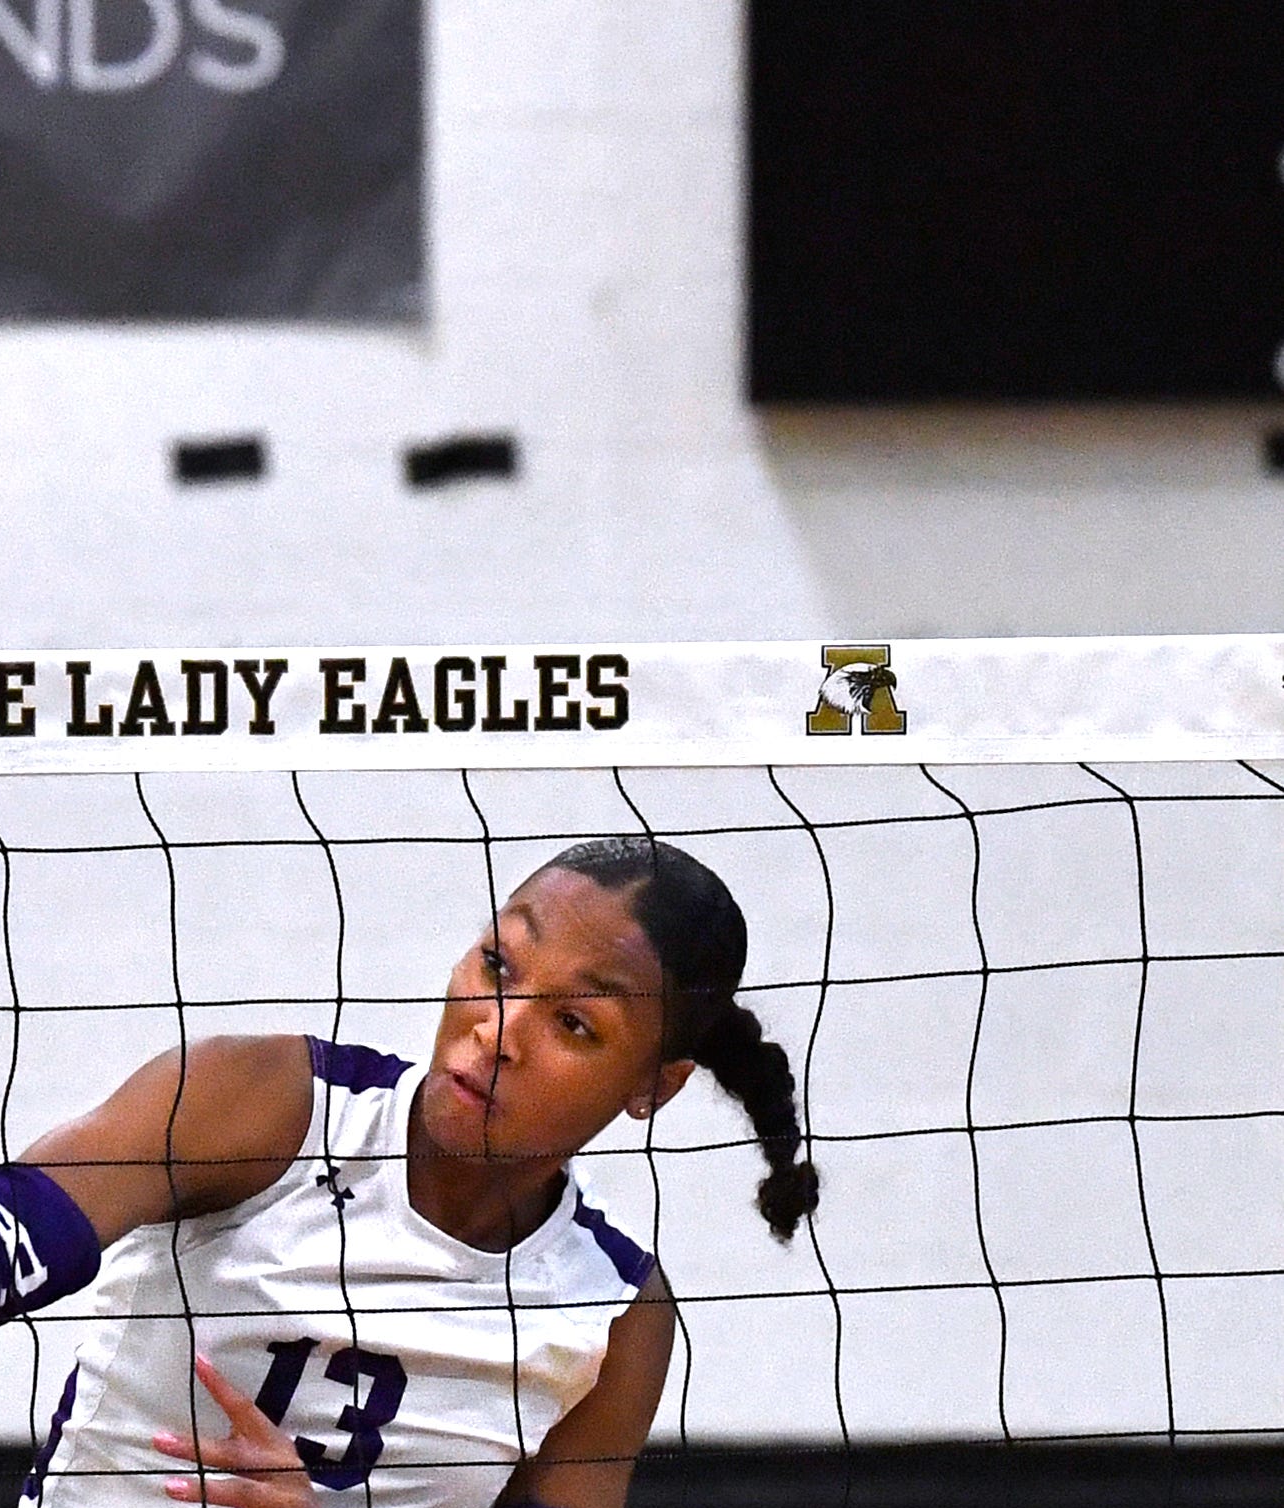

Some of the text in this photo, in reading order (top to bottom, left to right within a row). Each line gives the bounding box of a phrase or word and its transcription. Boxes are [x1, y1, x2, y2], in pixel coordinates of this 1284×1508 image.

[66, 659, 289, 737] LADY
[319, 653, 630, 734] EAGLES
[254, 1335, 409, 1492] 13
